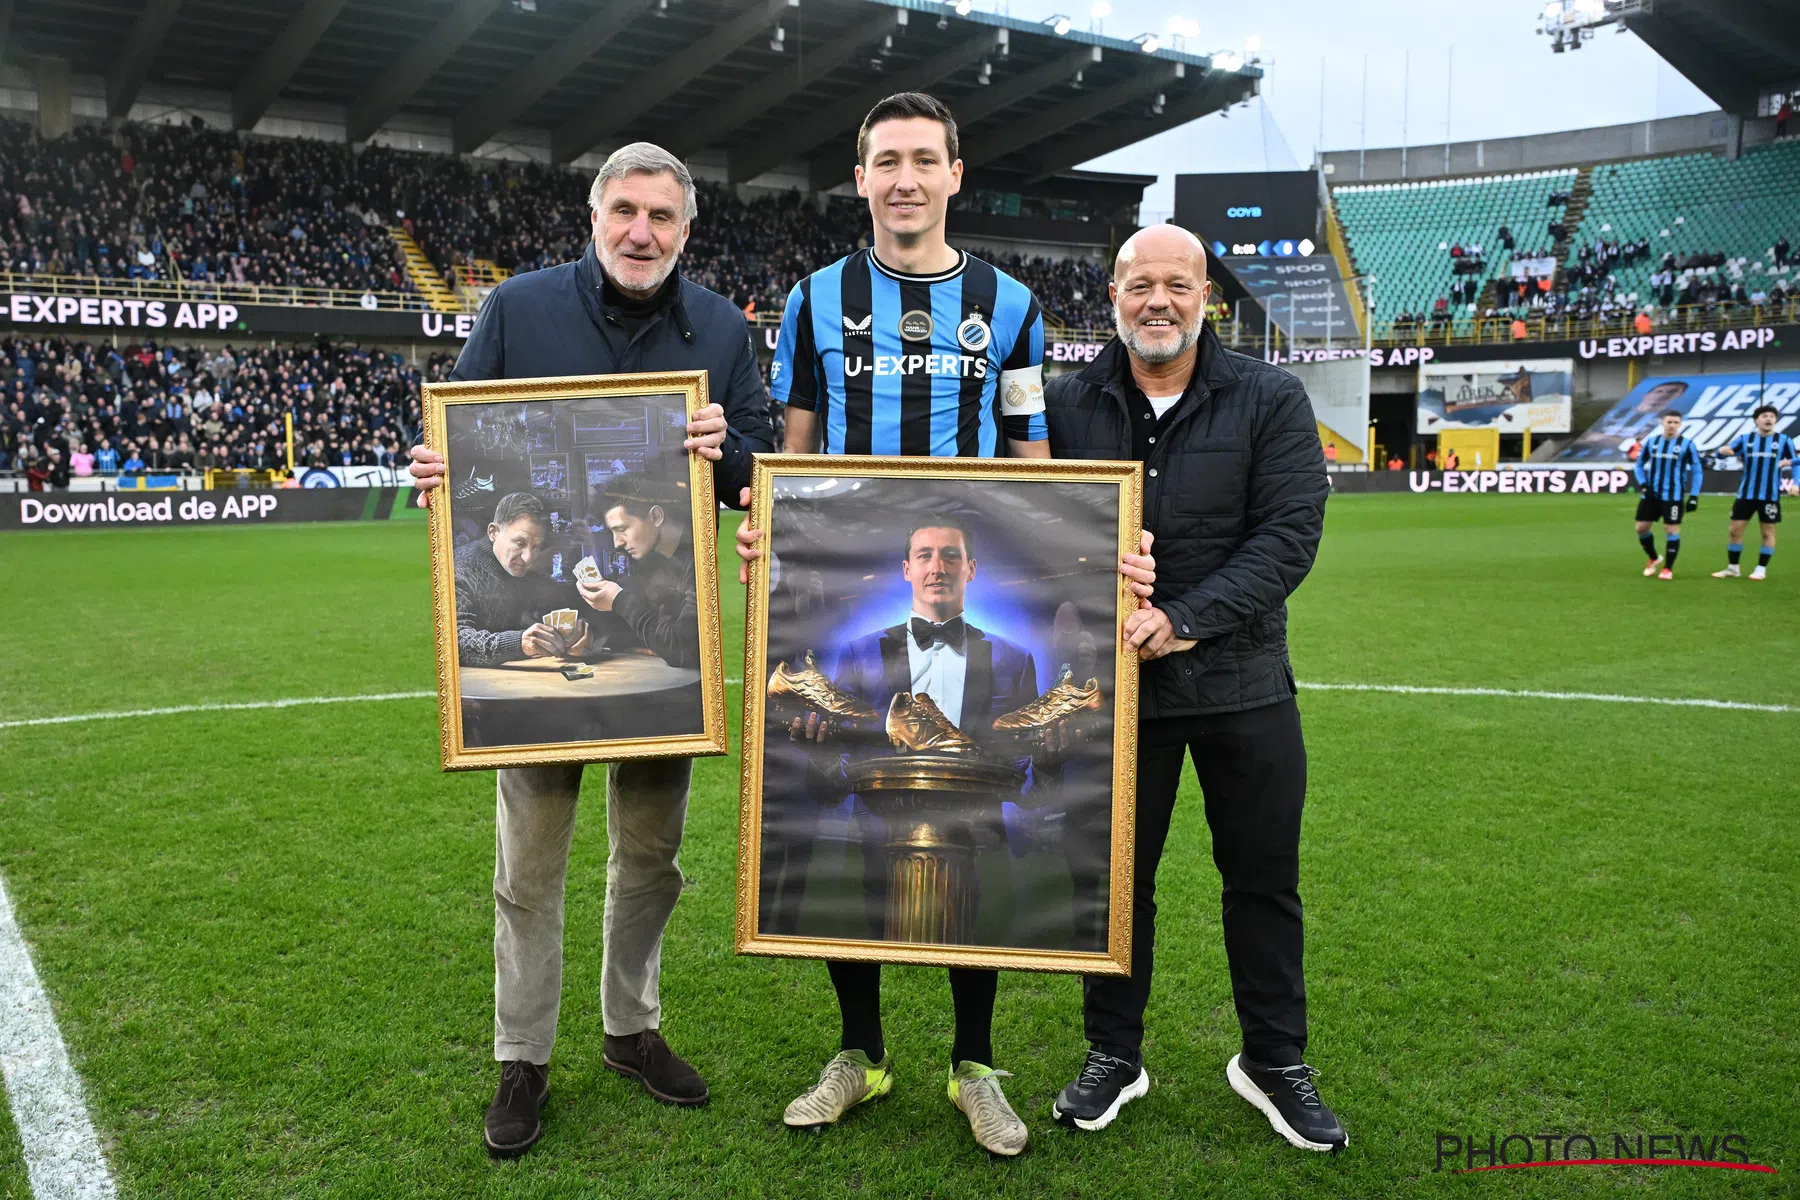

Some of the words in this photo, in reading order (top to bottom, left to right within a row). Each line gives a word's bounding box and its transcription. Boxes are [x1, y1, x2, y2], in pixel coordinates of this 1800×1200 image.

[422, 312, 477, 338] U-E
[1579, 331, 1717, 359] U-EXPERTS
[844, 354, 988, 379] U-EXPERTS
[1409, 470, 1567, 493] U-EXPERTS
[20, 497, 172, 524] Download
[179, 496, 216, 520] de
[221, 494, 278, 519] APP
